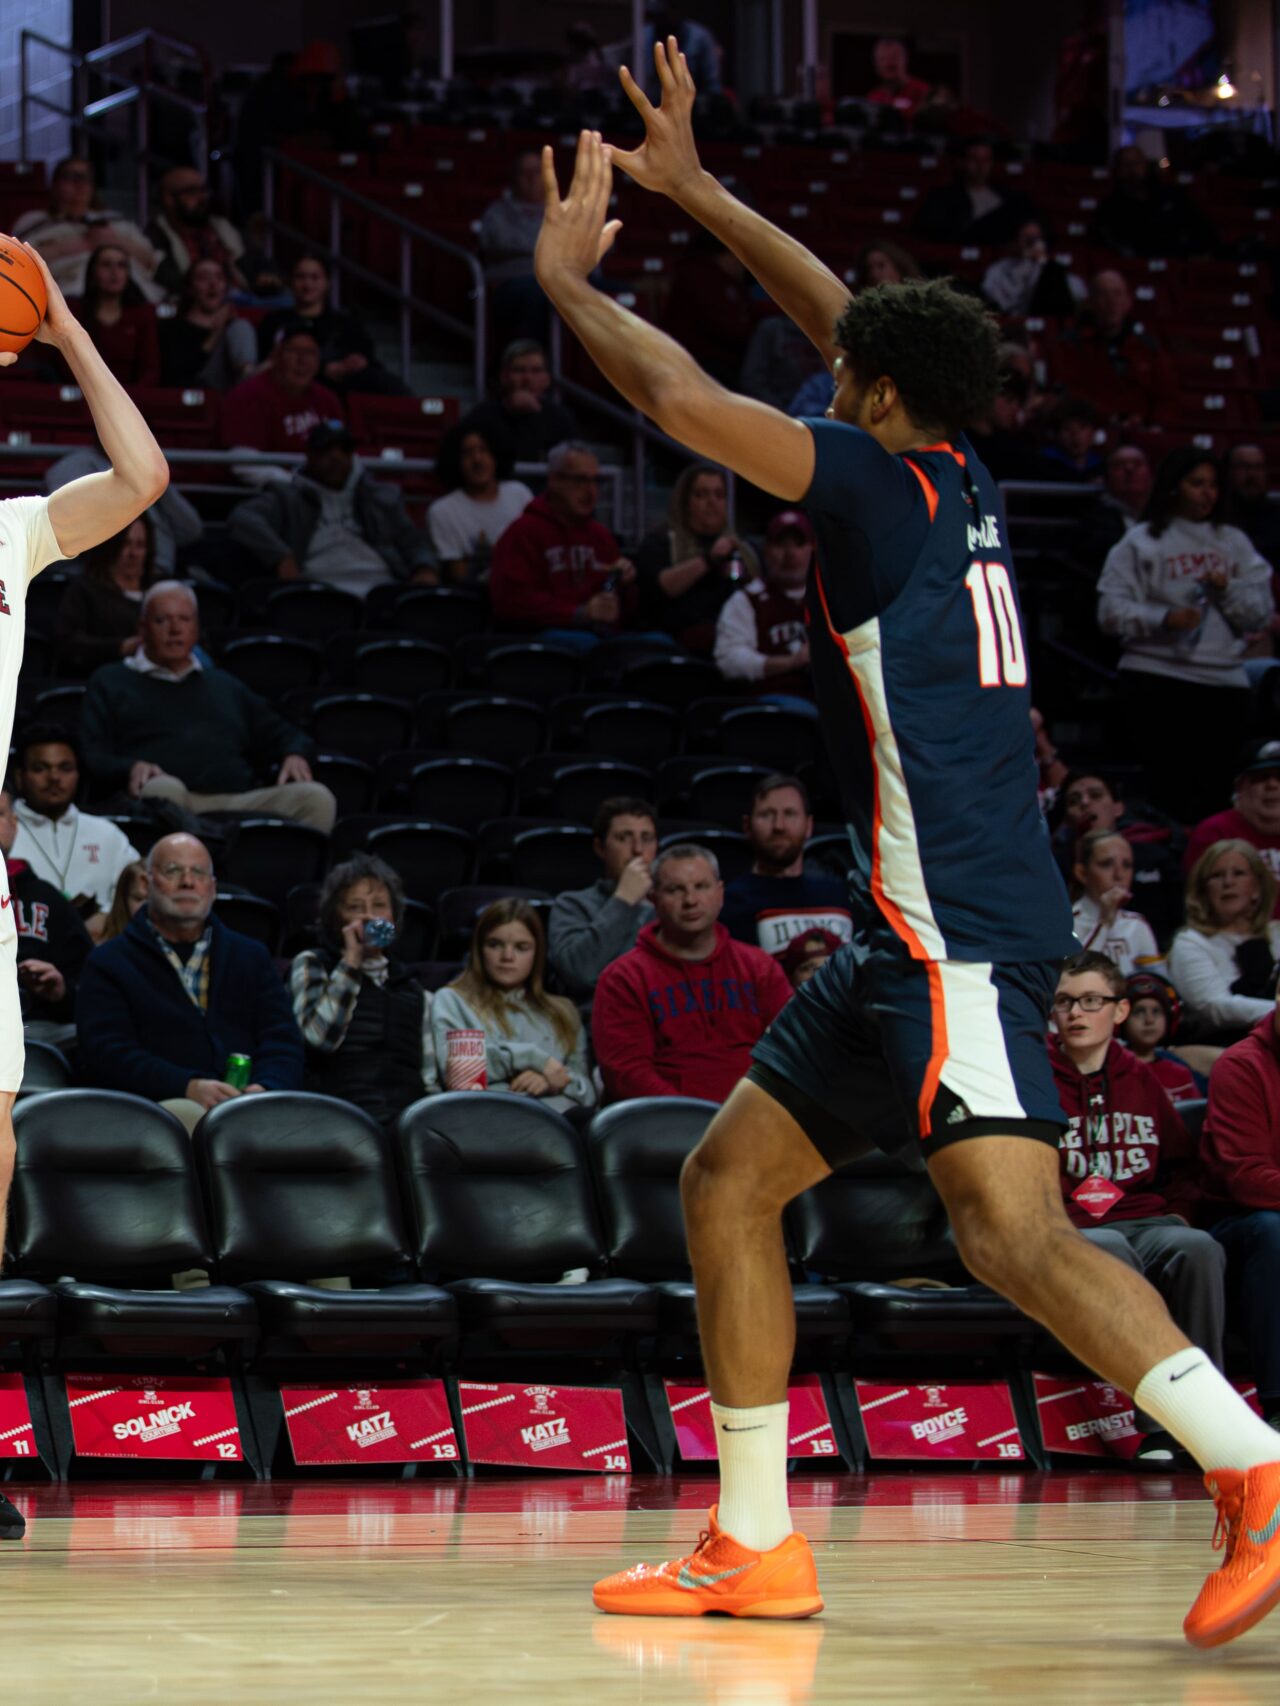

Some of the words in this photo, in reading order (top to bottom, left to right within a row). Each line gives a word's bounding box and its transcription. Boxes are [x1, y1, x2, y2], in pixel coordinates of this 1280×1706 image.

[964, 559, 1027, 688] 10
[82, 842, 100, 864] T
[1058, 1111, 1160, 1150] EMPLE
[112, 1401, 197, 1440] SOLNICK
[346, 1410, 396, 1442] KATZ
[520, 1416, 570, 1445] KATZ
[910, 1407, 969, 1440] BOYCE
[13, 1440, 30, 1455] 11
[216, 1443, 239, 1458] 12
[432, 1443, 457, 1459] 13
[810, 1439, 834, 1454] 15
[996, 1443, 1021, 1457] 16
[604, 1455, 627, 1470] 14
